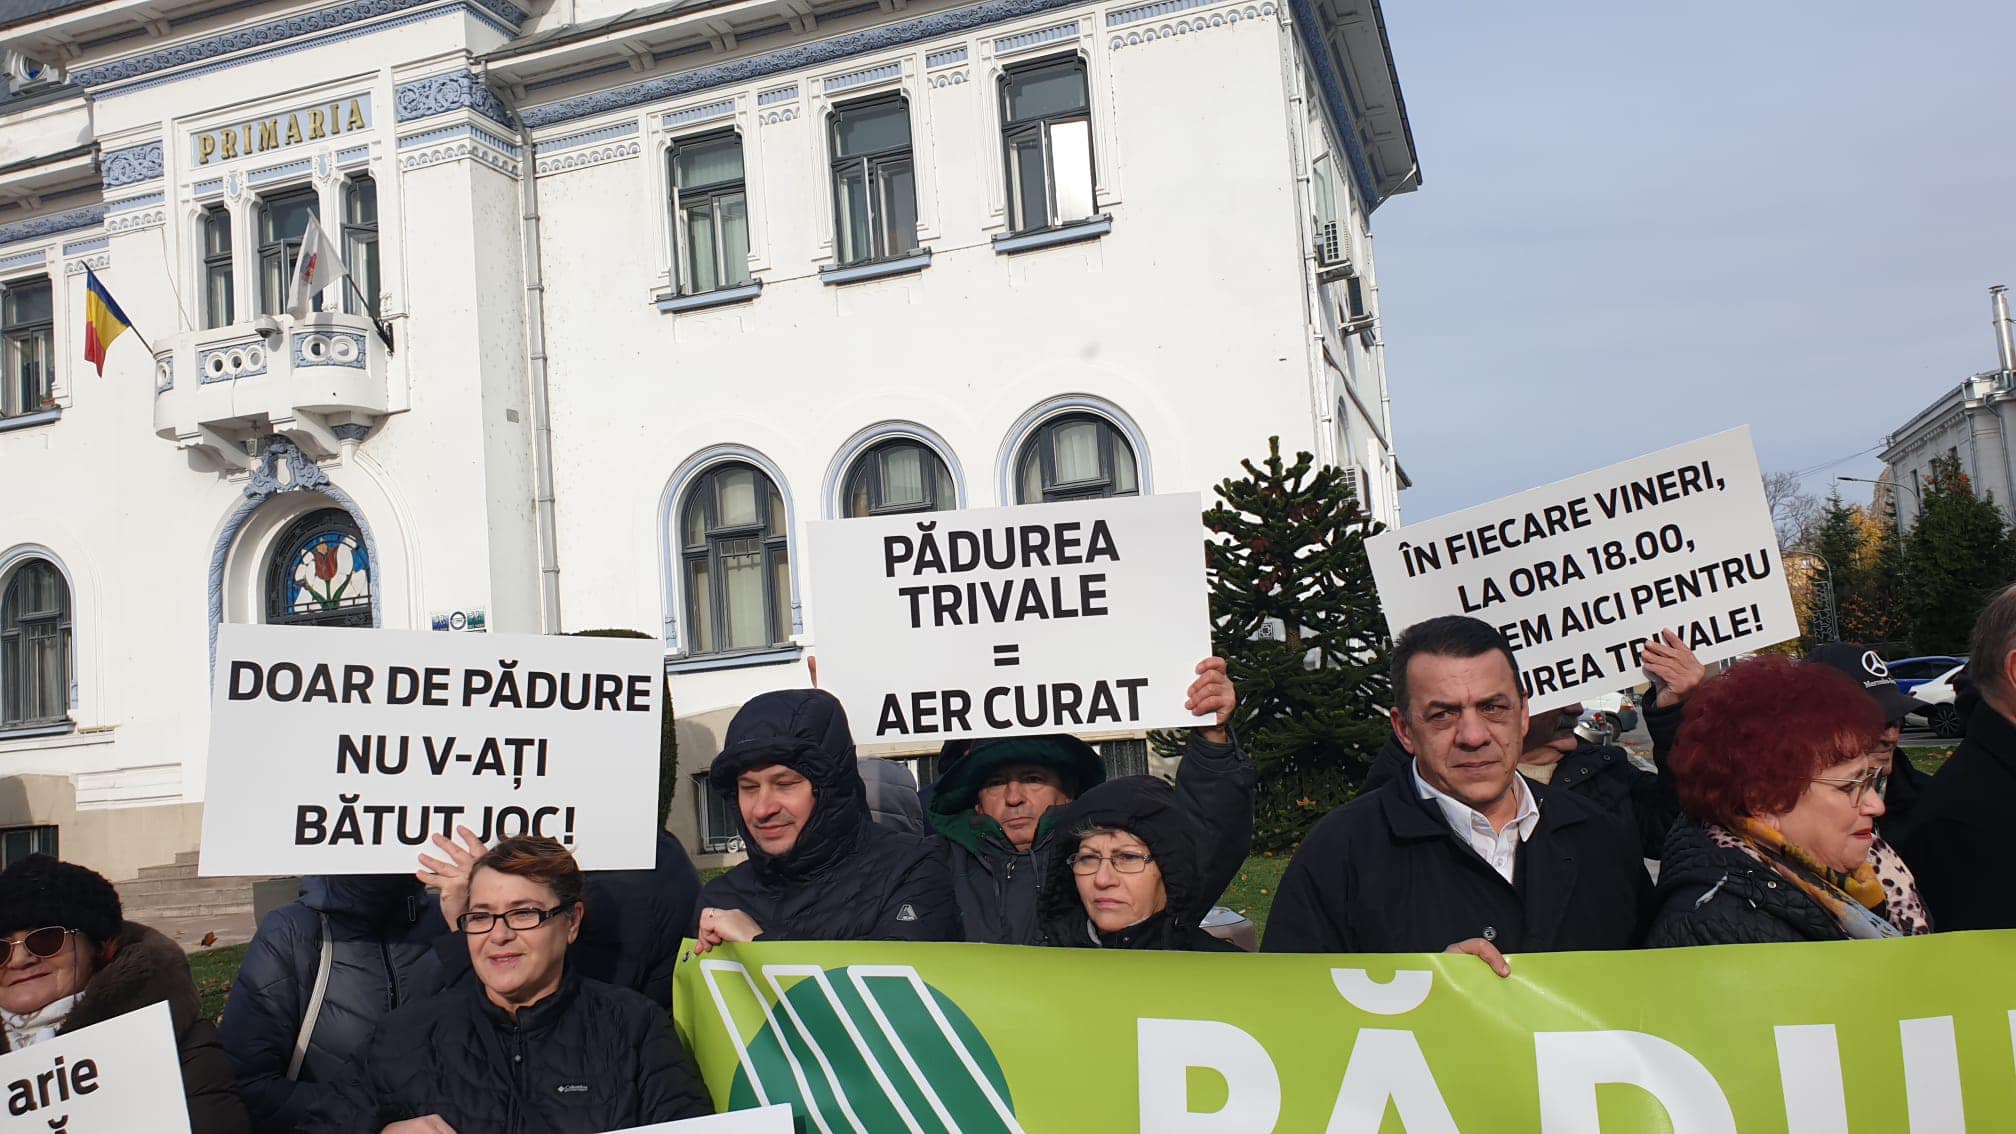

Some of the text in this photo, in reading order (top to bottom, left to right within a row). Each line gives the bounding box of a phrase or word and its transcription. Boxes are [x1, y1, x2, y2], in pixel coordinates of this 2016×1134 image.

[198, 98, 366, 165] PRIMARIA
[883, 520, 1121, 578] PĂDUREA
[1398, 460, 1726, 578] ÎN FIECARE VINERI,
[1457, 523, 1696, 614] LA ORA 18.00,
[1561, 592, 1628, 638] AICI
[1630, 548, 1771, 616] PENTRU
[898, 573, 1109, 628] TRIVALE
[228, 659, 652, 712] DOAR DE PĂDURE
[993, 644, 1020, 667] =
[876, 677, 1149, 737] AER CURAT
[336, 735, 549, 790] NU V-AȚI
[294, 794, 576, 846] BĂTUT JOC!
[1136, 967, 2016, 1134] PĂDU
[7, 1055, 100, 1117] arie
